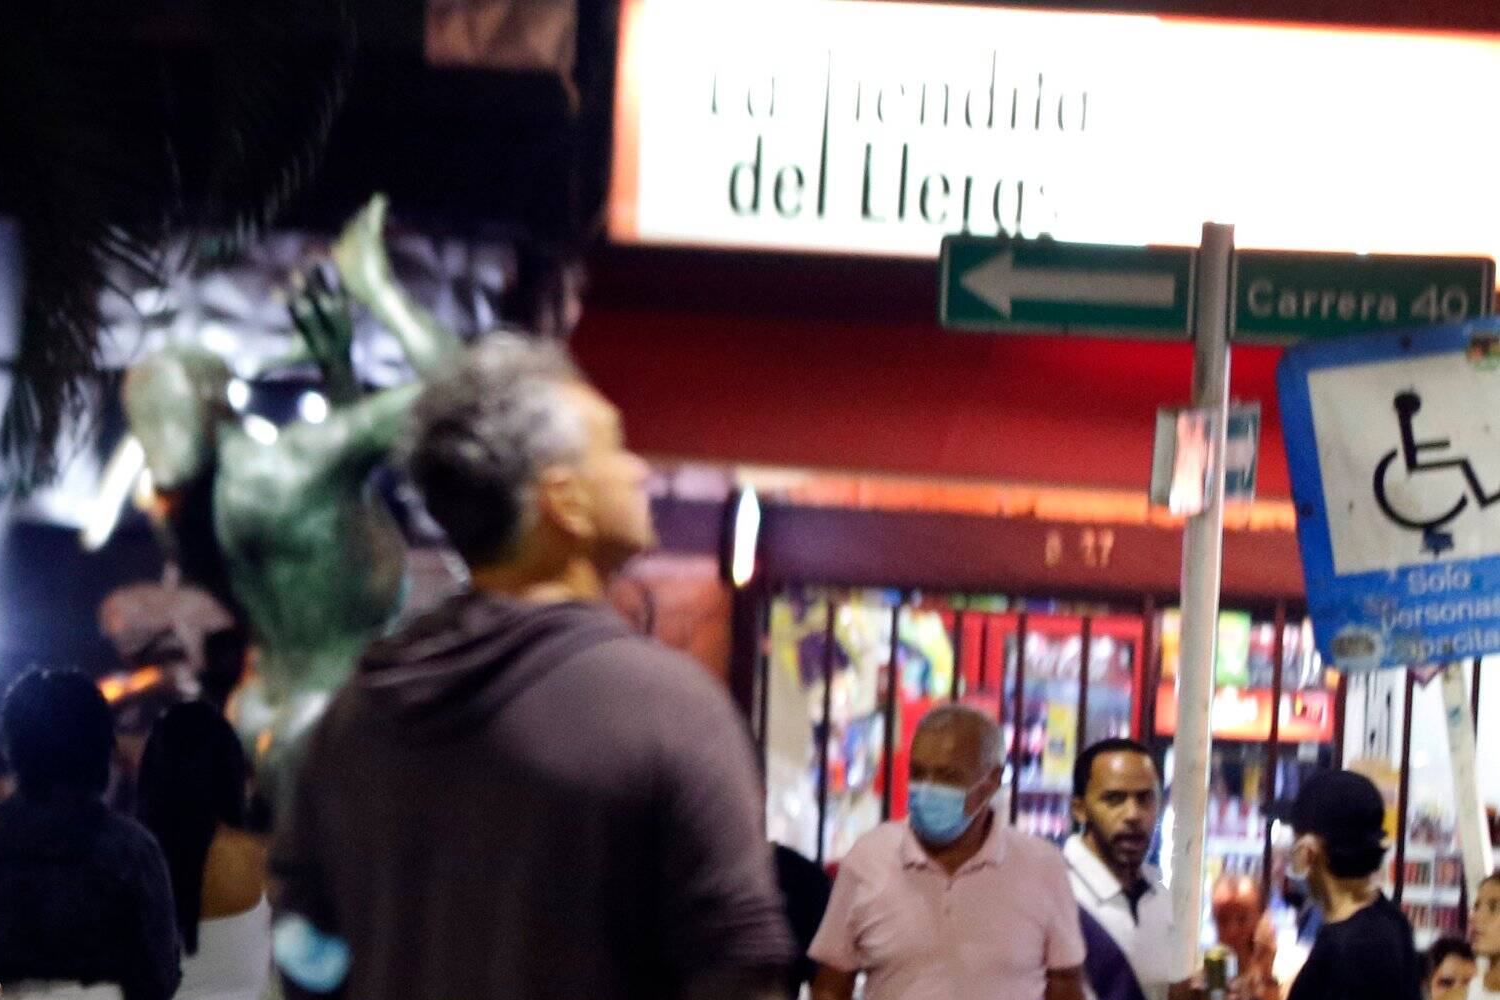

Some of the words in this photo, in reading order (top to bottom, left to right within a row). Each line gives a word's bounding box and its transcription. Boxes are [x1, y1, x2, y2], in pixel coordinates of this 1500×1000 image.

[728, 134, 828, 220] del
[860, 142, 1058, 238] Llera
[1248, 278, 1398, 323] Carrera
[1410, 284, 1469, 324] 40
[1407, 563, 1472, 596] Solo
